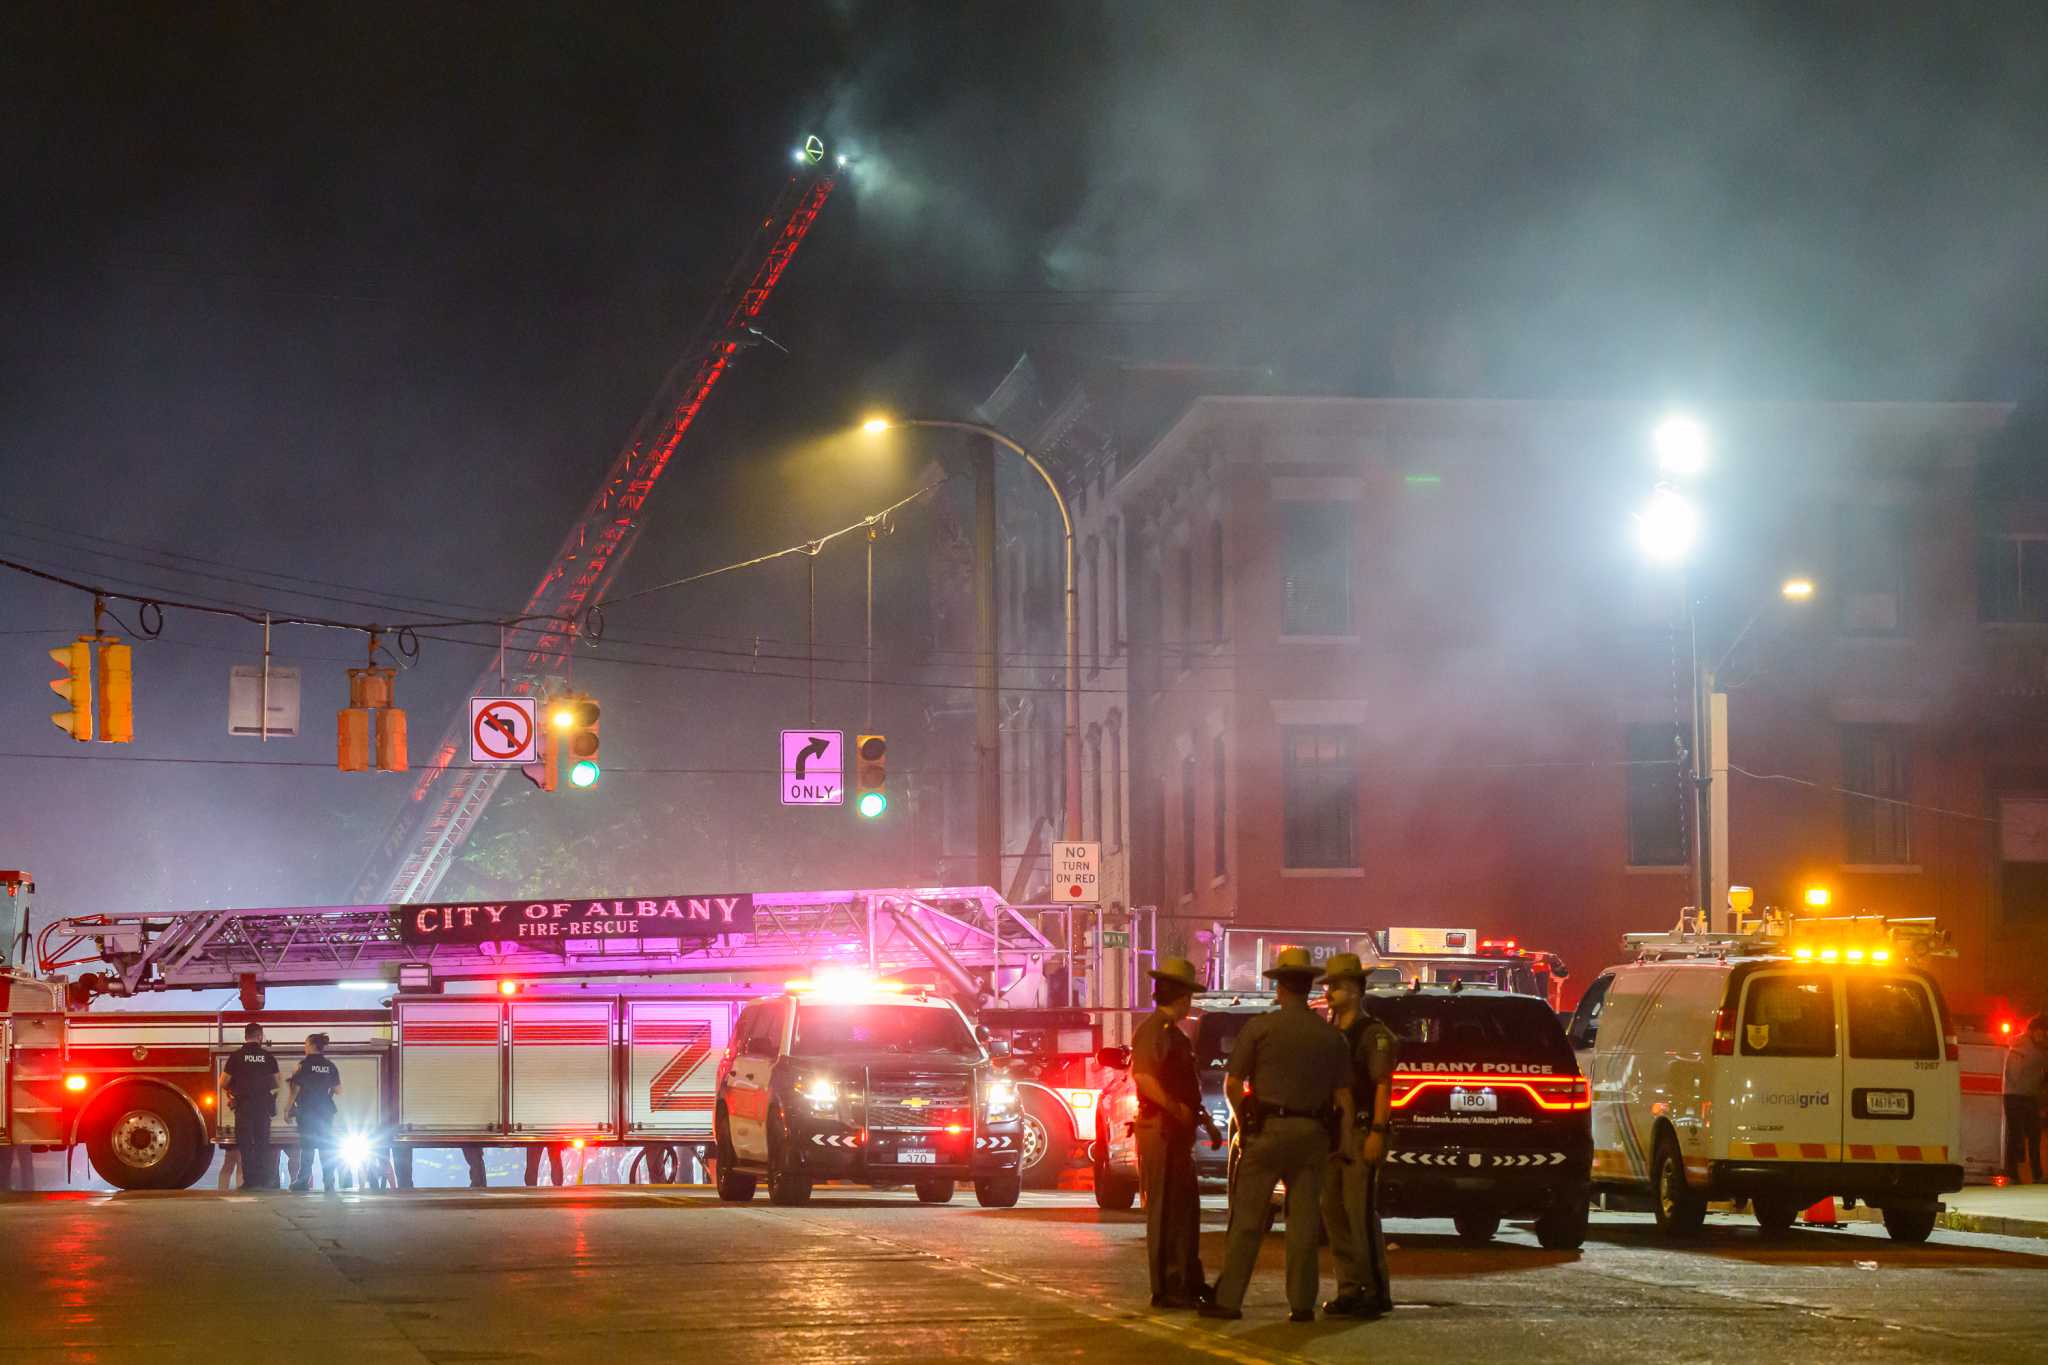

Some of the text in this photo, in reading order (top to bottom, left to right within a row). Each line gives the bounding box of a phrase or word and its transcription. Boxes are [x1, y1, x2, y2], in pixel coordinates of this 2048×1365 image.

[791, 785, 834, 799] ONLY
[1065, 846, 1086, 858] NO
[1063, 861, 1090, 871] TURN
[1056, 873, 1096, 883] ON RED
[416, 898, 741, 933] CITY OF ALBANY
[519, 920, 640, 937] FIRE-RESCUE
[244, 1055, 265, 1063] POLICE
[311, 1065, 330, 1074] POLICE
[1395, 1062, 1553, 1075] ALBANY POLICE
[1463, 1095, 1485, 1106] 180
[1413, 1115, 1533, 1126] facebook.com/AlbanyNYPolice
[907, 1154, 927, 1163] 370
